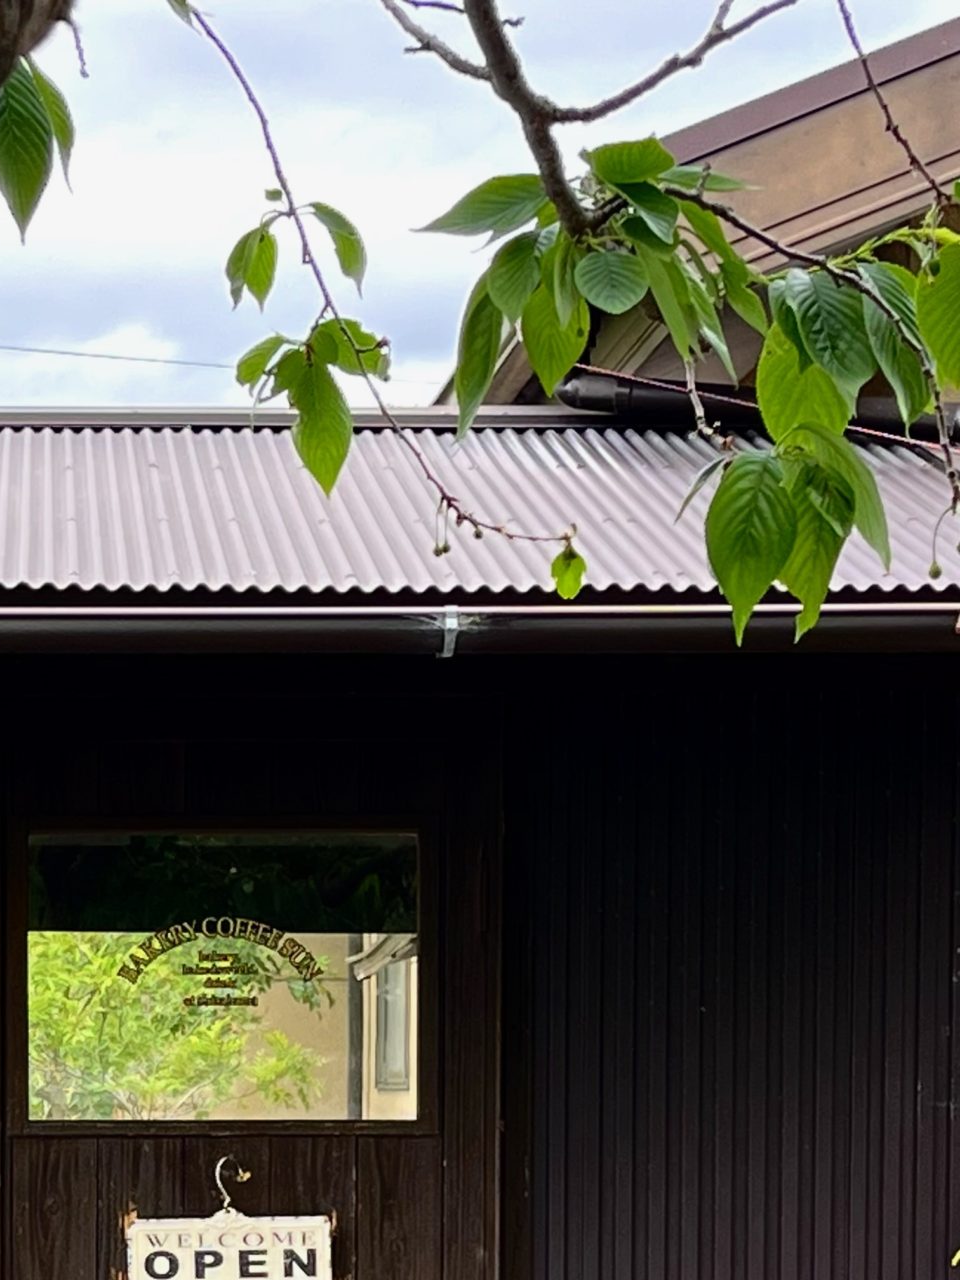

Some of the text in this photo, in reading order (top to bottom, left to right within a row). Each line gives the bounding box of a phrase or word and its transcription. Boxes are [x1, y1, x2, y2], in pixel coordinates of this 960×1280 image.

[117, 916, 324, 984] BAKERY COFFEE SUN
[145, 1230, 316, 1249] WELCOME
[144, 1248, 317, 1280] OPEN
